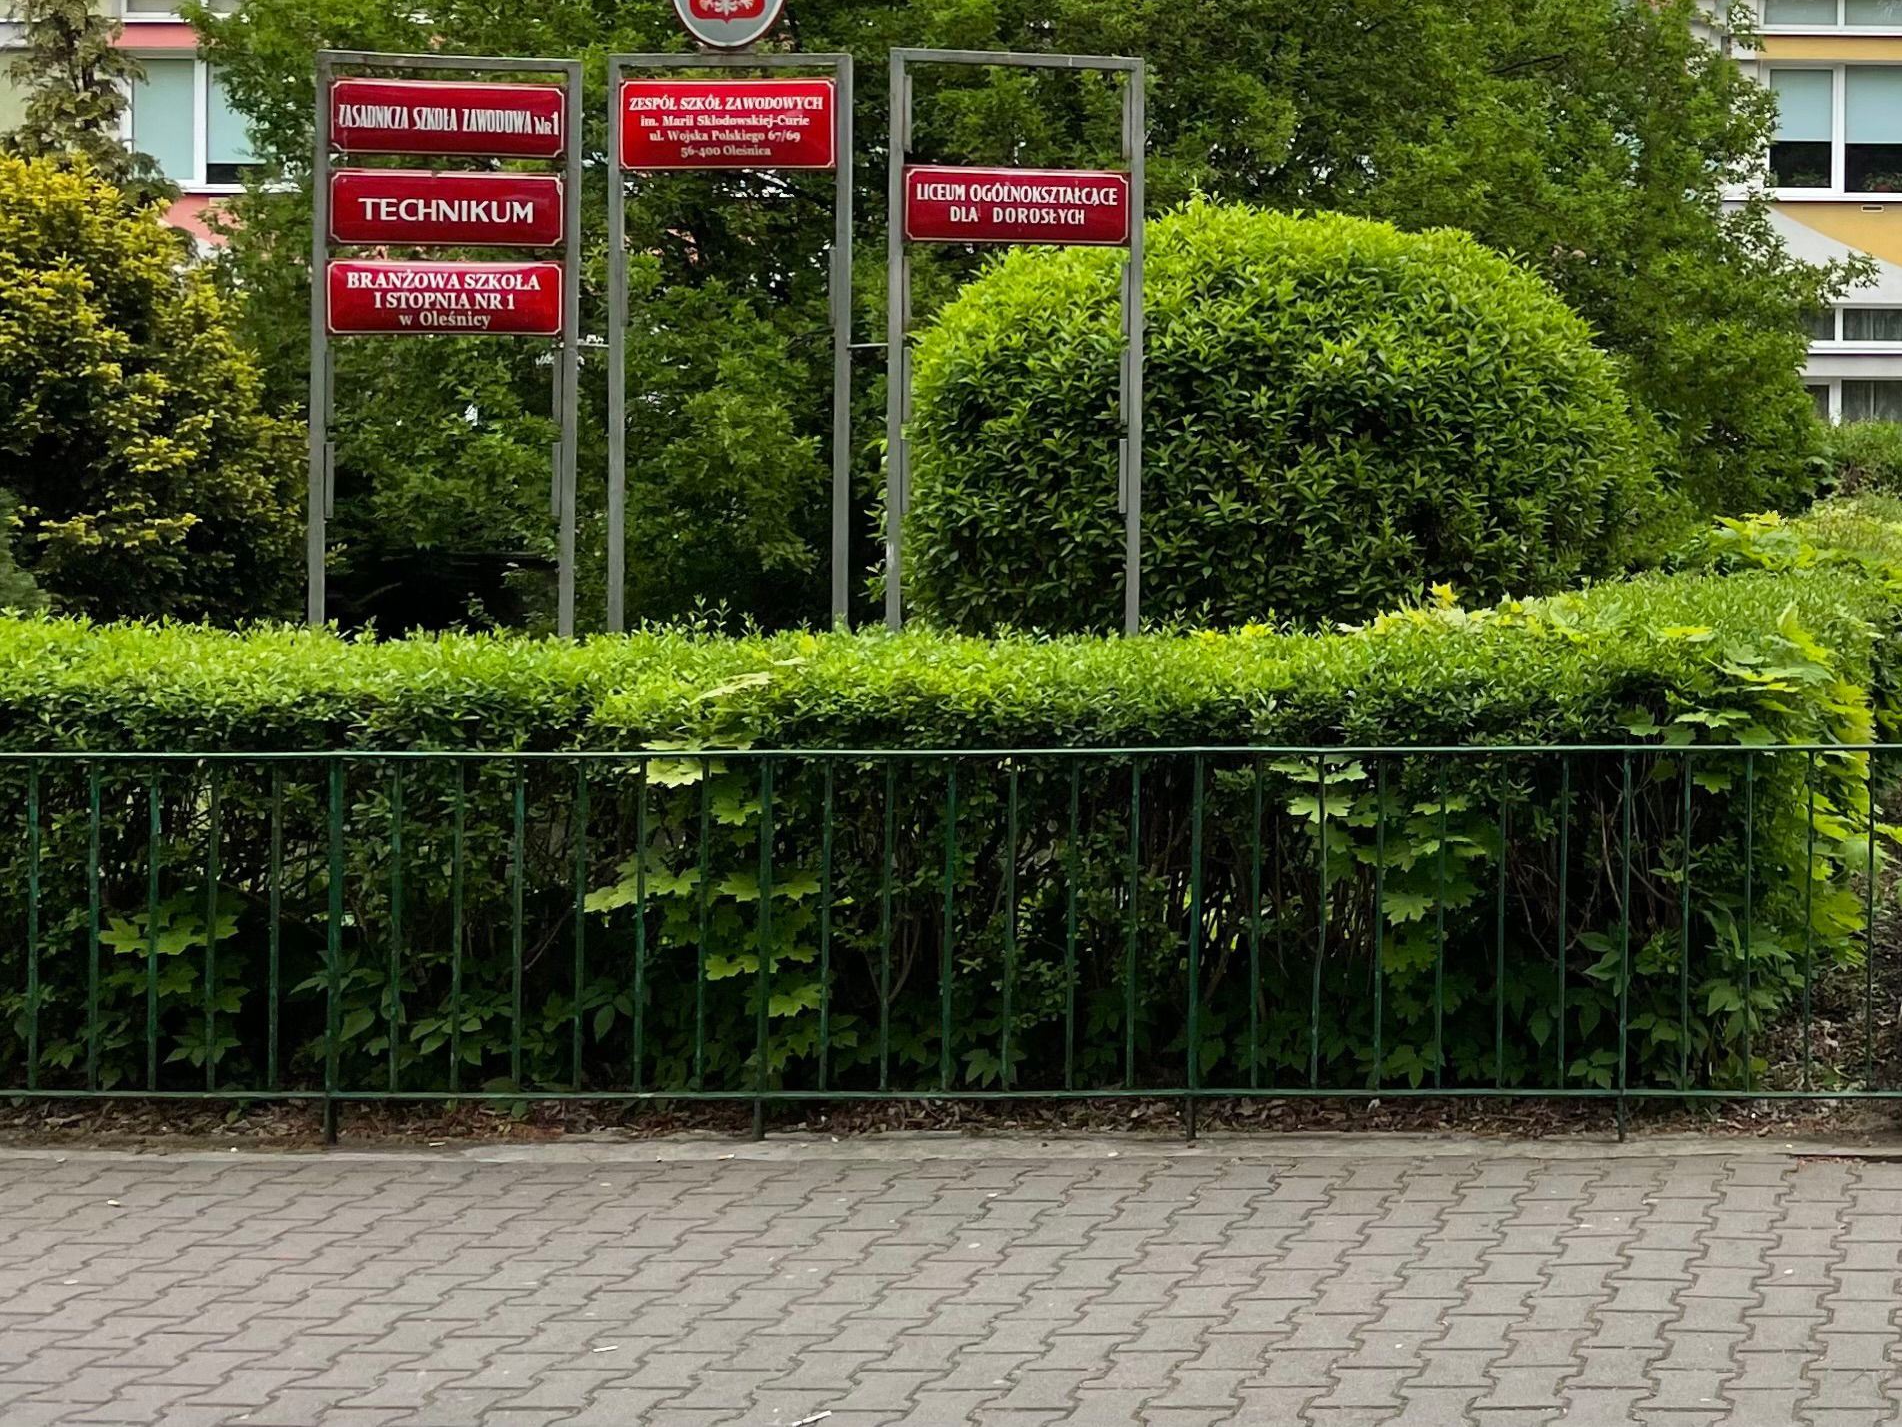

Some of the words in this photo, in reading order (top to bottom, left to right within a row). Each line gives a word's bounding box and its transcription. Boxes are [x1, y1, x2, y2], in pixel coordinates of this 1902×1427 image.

[629, 94, 677, 111] ZESPÓŁ
[725, 96, 824, 110] ZAWODOWYCH
[338, 104, 409, 130] ZASADNICZA
[412, 107, 458, 131] SZKOŁA
[462, 108, 533, 134] ZAWODOWA
[551, 111, 559, 136] 1
[640, 115, 659, 126] im.
[662, 115, 694, 126] Marii
[697, 114, 810, 128] Skłodowskiej-Curie
[649, 130, 664, 141] ul.
[667, 130, 709, 143] Wojska
[712, 129, 765, 143] Polskiego
[768, 130, 801, 143] 67/69
[680, 145, 720, 158] 56-400
[723, 144, 771, 156] Oleśnica
[916, 183, 966, 201] LICEUM
[969, 183, 1118, 207] OGÓLNOKSZTAŁCĄCE
[358, 198, 534, 224] TECHNIKUM
[950, 206, 979, 222] DLA
[993, 207, 1085, 225] DOROSŁYCH
[347, 268, 460, 290] BRANŻOWA
[463, 272, 541, 291] SZKOŁA
[374, 292, 382, 308] I
[386, 292, 470, 310] STOPNIA
[474, 293, 502, 310] NR
[507, 293, 515, 310] 1
[399, 315, 413, 326] w
[419, 311, 491, 330] Oleśnicy
